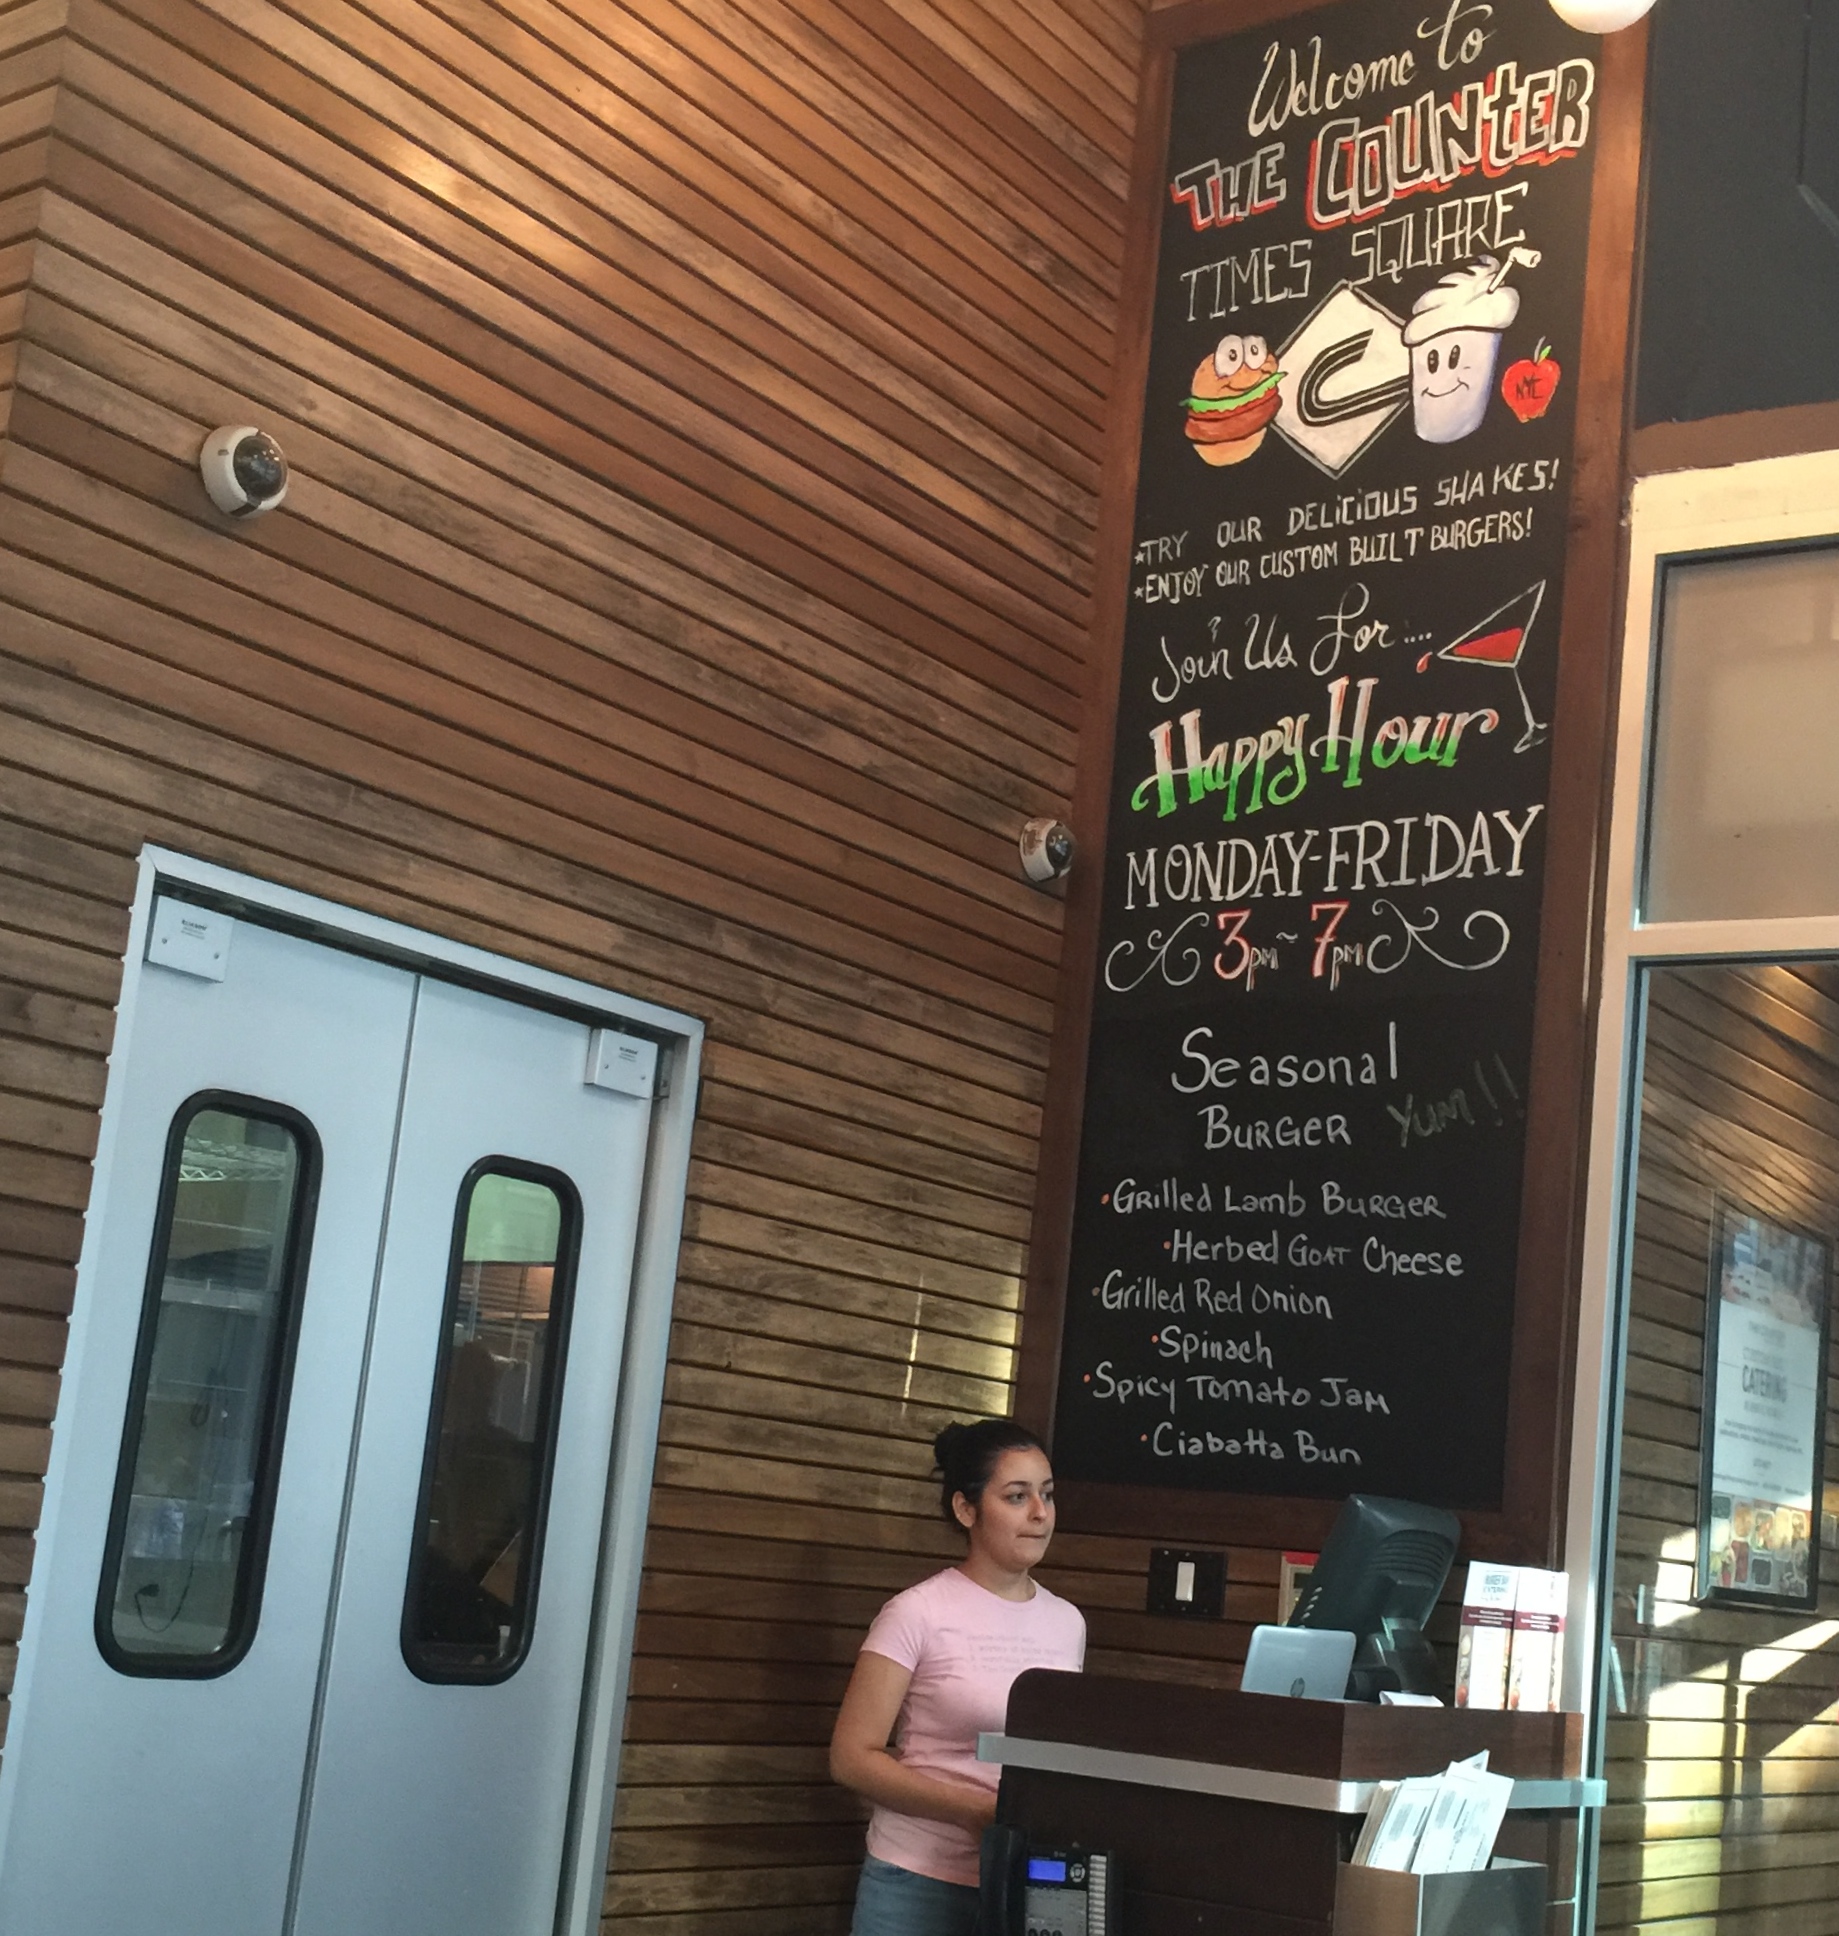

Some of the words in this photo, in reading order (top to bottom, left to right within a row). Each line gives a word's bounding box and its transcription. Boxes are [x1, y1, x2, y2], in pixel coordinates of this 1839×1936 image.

[1247, 36, 1416, 136] Welcome
[1417, 0, 1493, 70] to
[1171, 142, 1287, 231] THE
[1307, 59, 1594, 231] COUNTER
[1180, 240, 1312, 321] TIMES
[1351, 182, 1528, 286] SQUARE
[1140, 531, 1188, 566] TRY
[1217, 517, 1262, 548] OUR
[1287, 486, 1418, 536] DELICIOUS
[1437, 459, 1559, 506] SHAKES!
[1145, 563, 1208, 604] ENJOY
[1216, 560, 1251, 587] OUR
[1260, 543, 1338, 579] CUSTOM
[1349, 528, 1423, 566] BUILT
[1430, 507, 1533, 550] BURGERS!
[1152, 616, 1233, 703] Join
[1245, 613, 1298, 670] Us
[1131, 709, 1310, 822] Happy
[1309, 675, 1500, 788] Hour
[1170, 1021, 1397, 1094] Seasonal
[1225, 1179, 1307, 1218] Lamb
[1171, 1228, 1279, 1265] Herbed
[1362, 1236, 1465, 1277] Cheese
[1101, 1269, 1186, 1313] Grilled
[1193, 1278, 1243, 1315] Red
[1251, 1283, 1333, 1320] Onion
[1092, 1360, 1175, 1415] Spicy
[1186, 1375, 1311, 1406] Tomato
[1158, 1325, 1273, 1369] Spinach
[1152, 1421, 1285, 1460] Ciabatta
[1293, 1429, 1362, 1466] Bun
